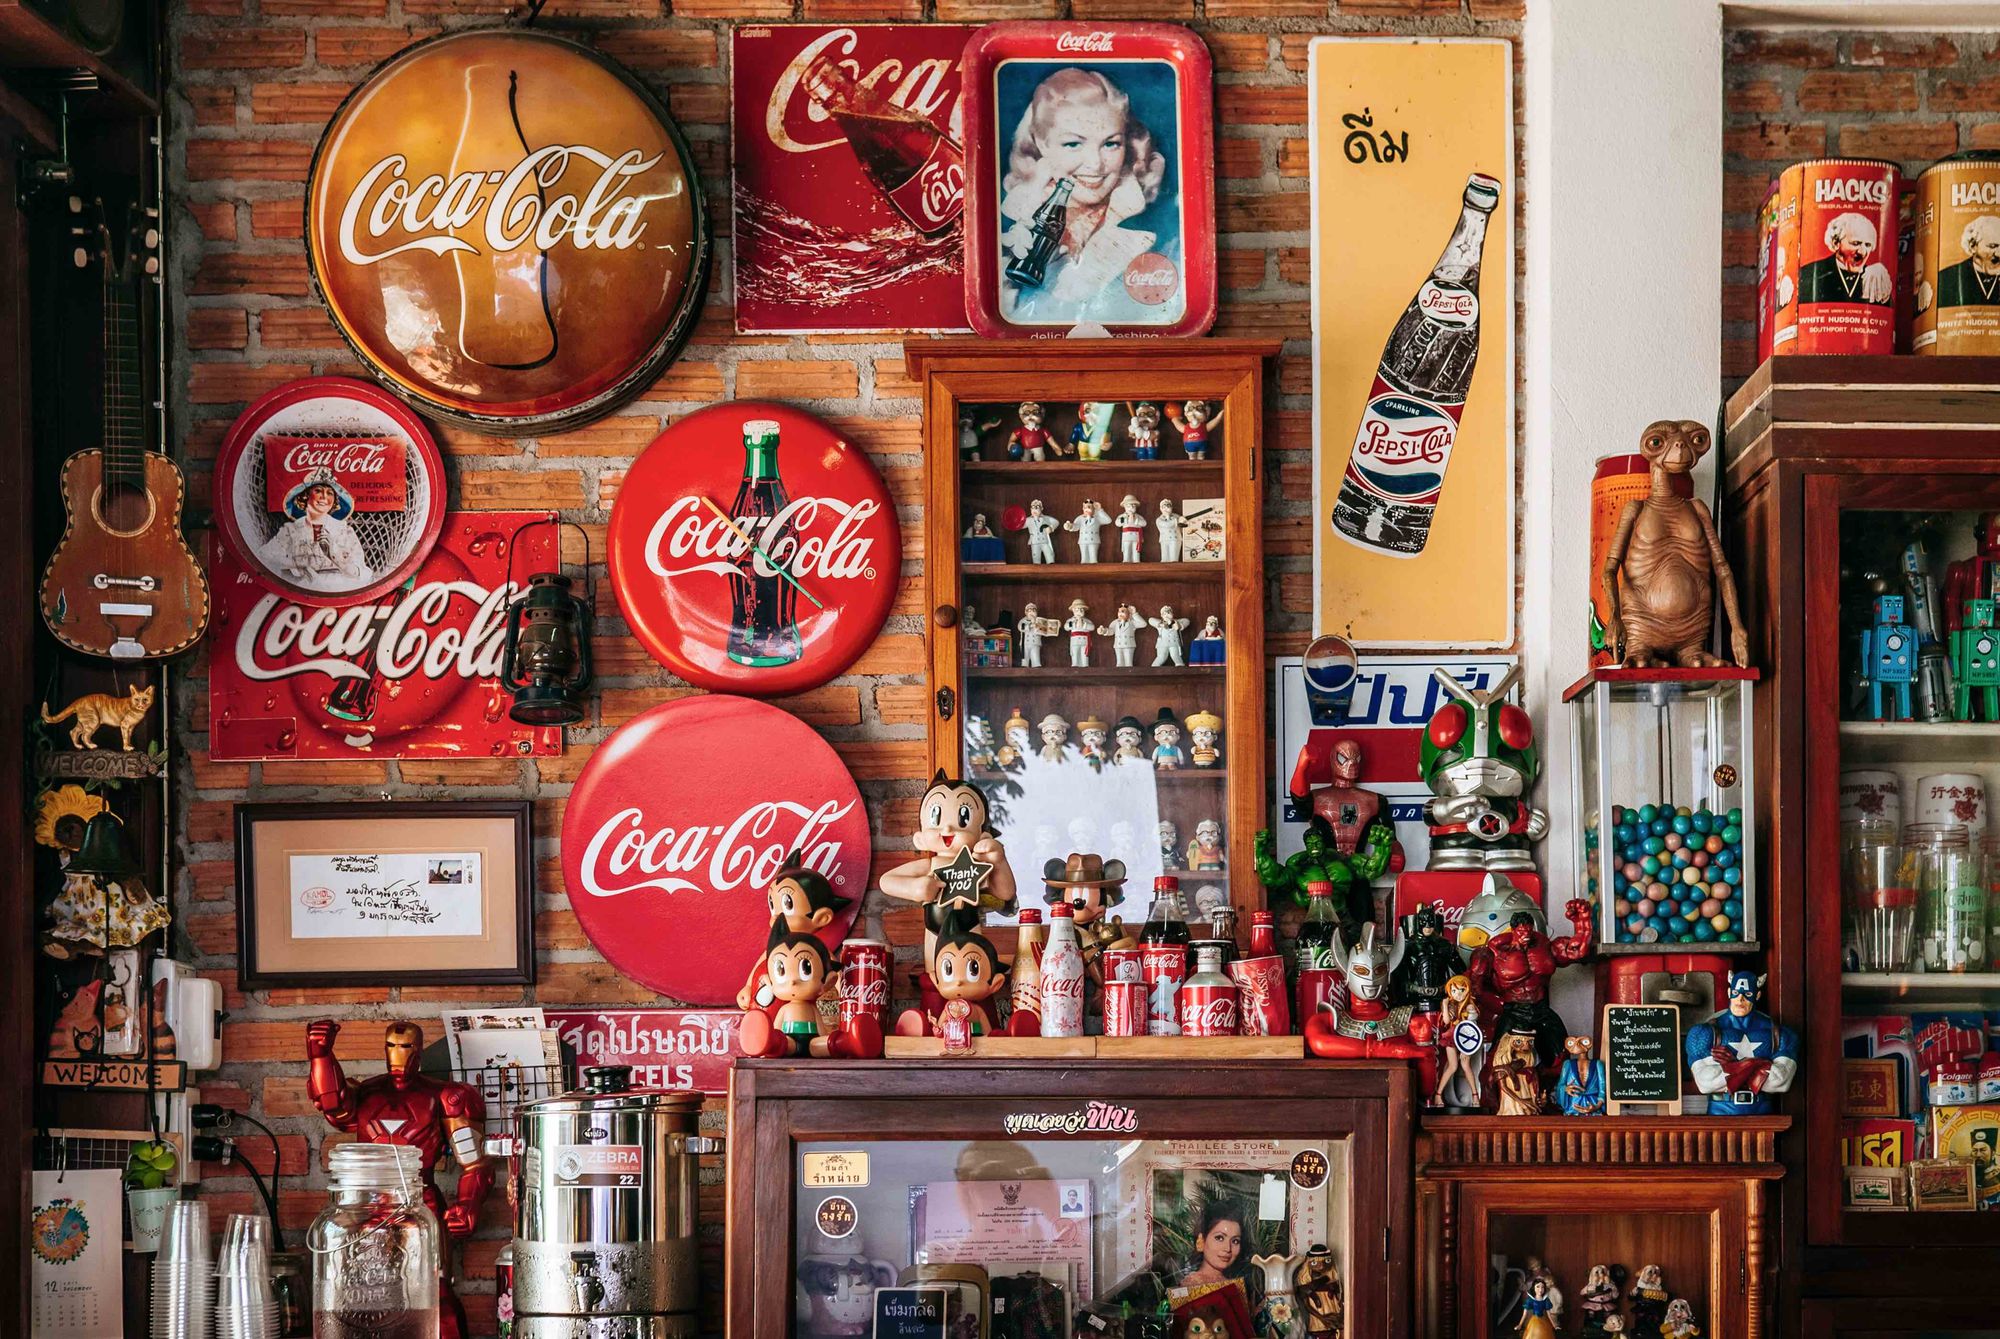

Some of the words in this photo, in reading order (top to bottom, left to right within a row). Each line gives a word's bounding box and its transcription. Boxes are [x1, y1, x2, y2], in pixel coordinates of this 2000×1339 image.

[1057, 31, 1116, 52] Coca-Cola
[1343, 107, 1409, 164] ดื่ม
[1815, 179, 1888, 203] HACKS
[338, 145, 664, 266] Coca-Cola
[1126, 269, 1174, 286] Coca-Cola
[1799, 316, 1825, 324] WHITE
[1828, 316, 1861, 324] HUDSON
[1937, 320, 1963, 328] WHITE
[1966, 319, 1998, 327] HUDSON
[1030, 331, 1066, 339] delici
[1385, 400, 1420, 416] SPARKLING
[283, 443, 389, 473] Coca-Cola
[644, 495, 881, 580] Coca-Cola
[40, 756, 136, 778] WELCOME
[580, 800, 855, 897] Coca-Cola
[943, 865, 979, 880] Thank
[949, 879, 972, 894] you
[1143, 953, 1181, 968] Coca-Cola
[1256, 968, 1270, 1007] CLASSIC
[550, 1014, 732, 1064] ัสดุไปรษณีย์
[53, 1064, 162, 1085] WELCOME
[1942, 1072, 1973, 1082] Colgate
[1171, 1142, 1200, 1150] THAI
[1205, 1142, 1228, 1150] LEE
[1234, 1142, 1275, 1150] STORE
[587, 1152, 639, 1163] ZEBRA
[1302, 1154, 1319, 1164] บ้าน
[1294, 1163, 1325, 1175] จงรัก
[620, 1175, 634, 1185] 22
[813, 1172, 860, 1183] จำหน่าย
[830, 1202, 846, 1210] บ้าน
[821, 1210, 851, 1222] จงรัก
[44, 1280, 58, 1293] 12
[885, 1297, 936, 1318] เข็มกลัด
